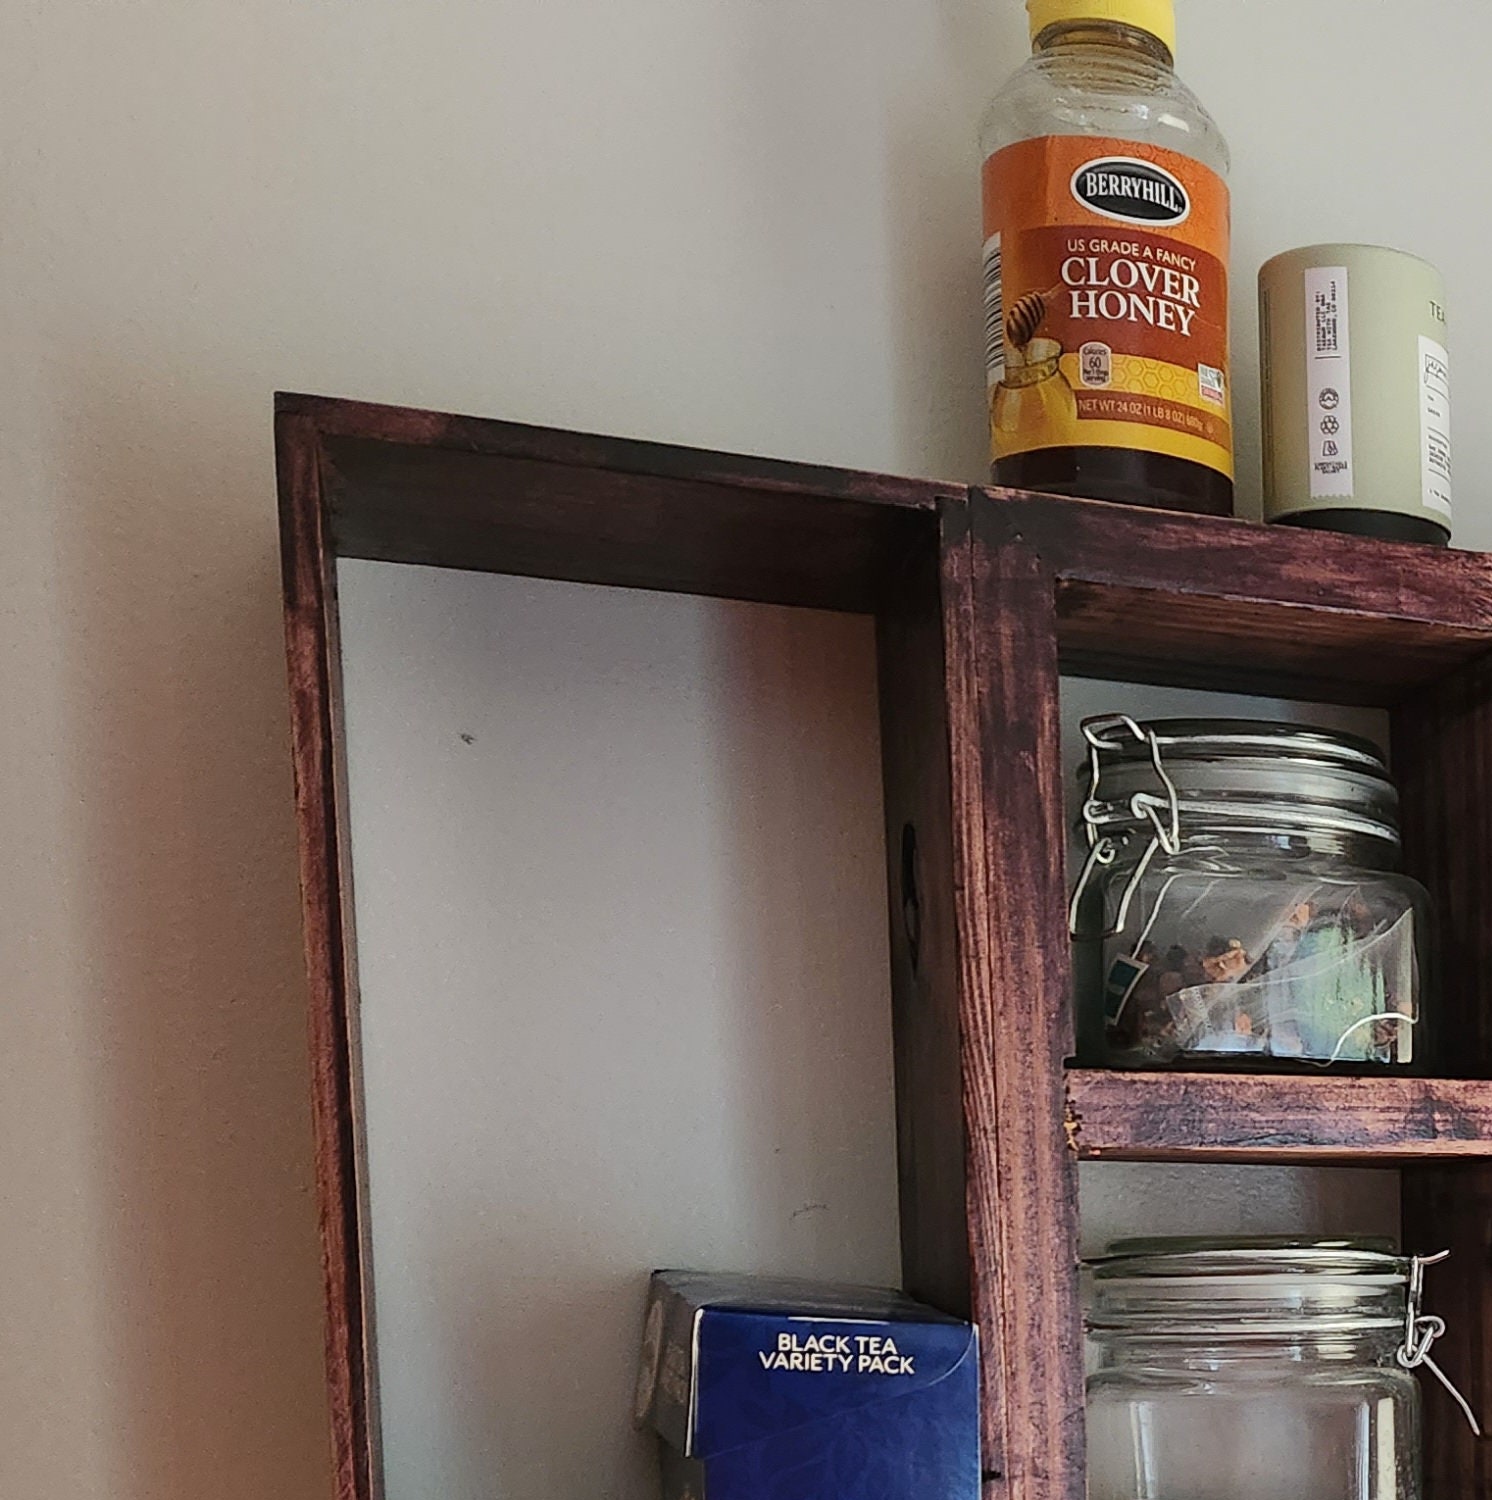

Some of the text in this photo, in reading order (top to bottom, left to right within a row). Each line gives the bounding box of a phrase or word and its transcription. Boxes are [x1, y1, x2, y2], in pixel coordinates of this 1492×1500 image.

[1086, 172, 1179, 213] BERRYHILL
[1067, 238, 1196, 273] US GRADE A FANCY
[1061, 256, 1200, 308] CLOVER
[1069, 290, 1196, 337] HONEY
[1089, 356, 1101, 369] 60
[1079, 399, 1096, 411] NET
[1099, 400, 1116, 412] WT
[1117, 401, 1128, 413] 24
[1129, 402, 1142, 415] OZ
[1153, 407, 1164, 420] LB
[778, 1333, 897, 1355] BLACK TEA
[759, 1351, 915, 1375] VARIETY PACK
